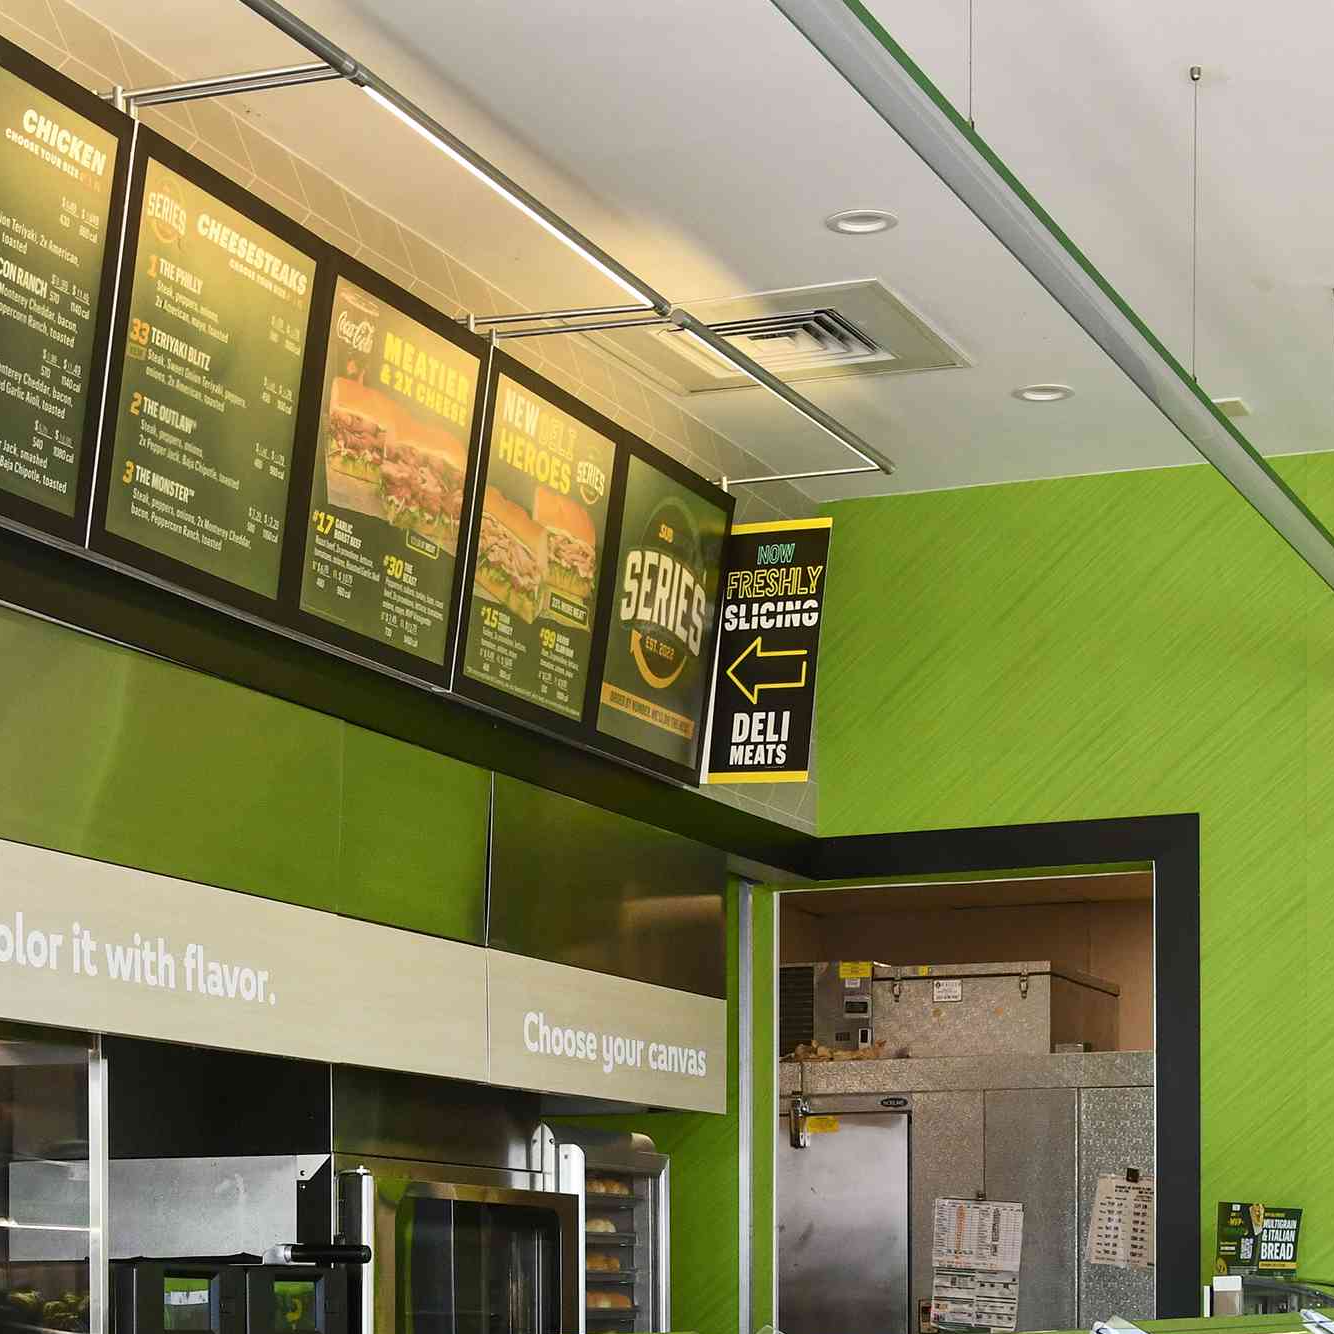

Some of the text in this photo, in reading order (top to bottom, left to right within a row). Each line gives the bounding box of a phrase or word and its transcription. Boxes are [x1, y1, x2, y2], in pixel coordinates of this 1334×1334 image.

[23, 109, 106, 176] CHICKEN
[148, 192, 187, 236] SERIES
[197, 213, 307, 295] CHEESESTEAKS
[15, 260, 47, 300] RANCH
[130, 318, 150, 345] 33
[151, 327, 211, 370] TERIYAKI BLITZ
[382, 332, 469, 396] MEATIER
[143, 396, 159, 418] THE
[416, 385, 467, 428] CHEESE
[502, 387, 539, 437] NEW
[136, 465, 150, 486] THE
[498, 428, 571, 495] HEROES
[577, 461, 605, 497] SERIES
[757, 543, 795, 565] NOW
[727, 565, 823, 599] FRESHLY
[619, 549, 706, 657] SERIES
[724, 599, 819, 631] SLICING
[731, 711, 790, 743] DELI
[729, 744, 787, 765] MEATS
[71, 922, 98, 977] it
[107, 933, 177, 990] with
[182, 943, 277, 1006] flavor.
[522, 1011, 707, 1078] Choose your canvas
[1260, 1243, 1293, 1260] BREAD
[1269, 1230, 1296, 1242] ITALIAN
